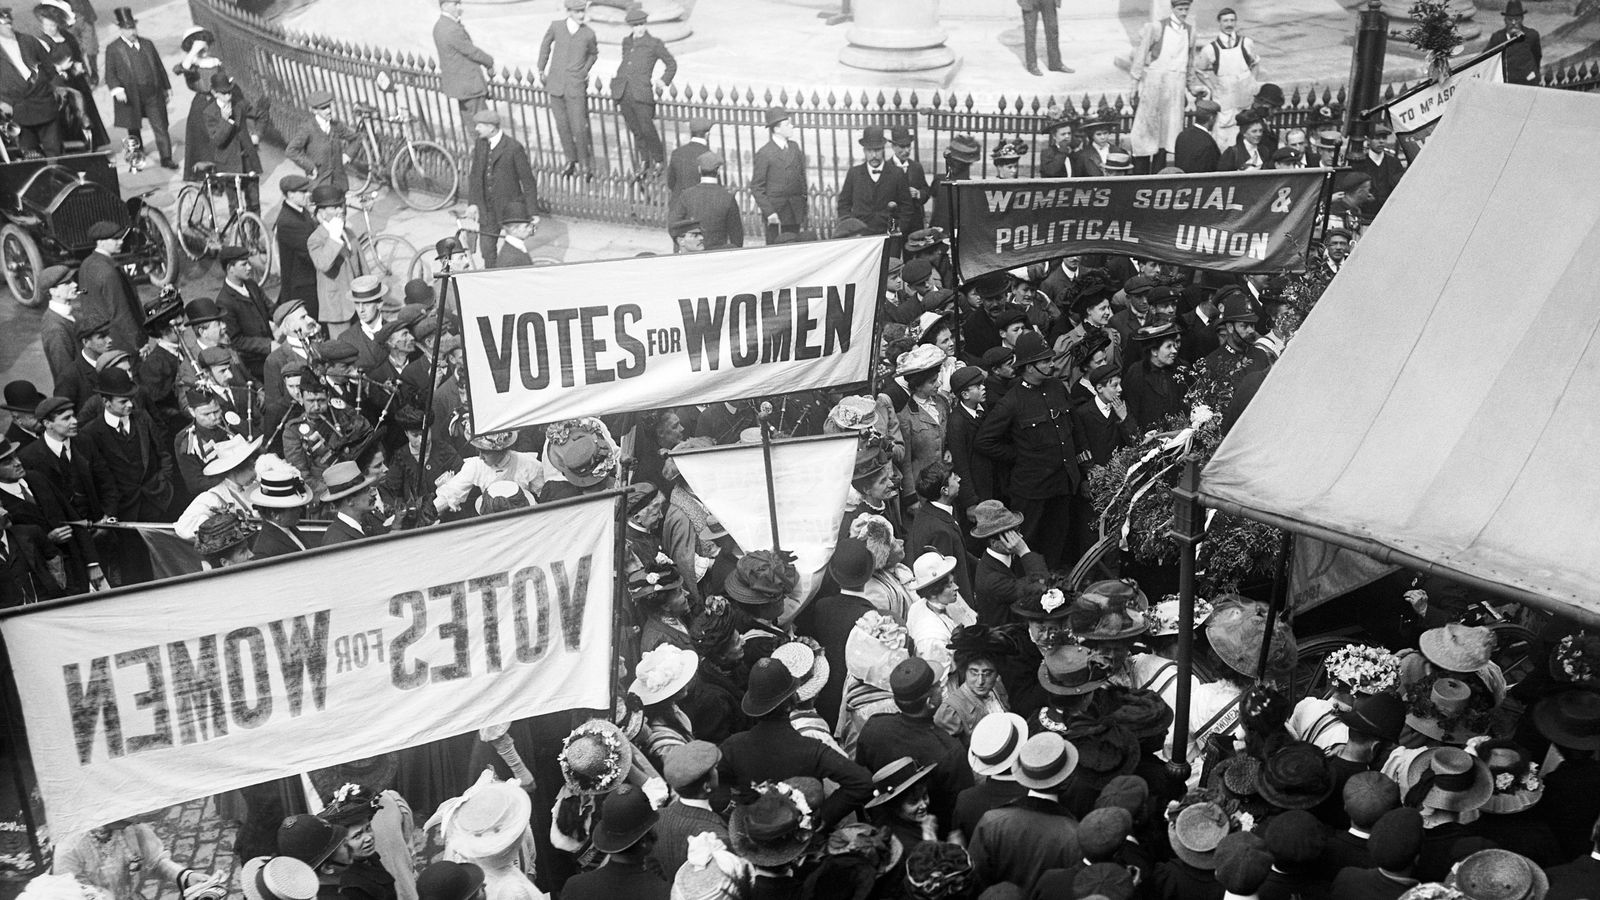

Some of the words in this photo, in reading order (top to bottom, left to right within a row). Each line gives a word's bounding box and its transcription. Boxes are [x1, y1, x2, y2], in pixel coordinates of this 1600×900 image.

[1399, 108, 1415, 124] TO
[985, 187, 1111, 213] WOMEN'S
[1133, 186, 1243, 211] SOCIAL
[1271, 186, 1292, 213] &
[996, 219, 1139, 254] POLITICAL
[1175, 224, 1270, 261] UNION
[476, 303, 646, 394] VOTES
[647, 327, 682, 357] FOR
[678, 283, 856, 372] WOMEN
